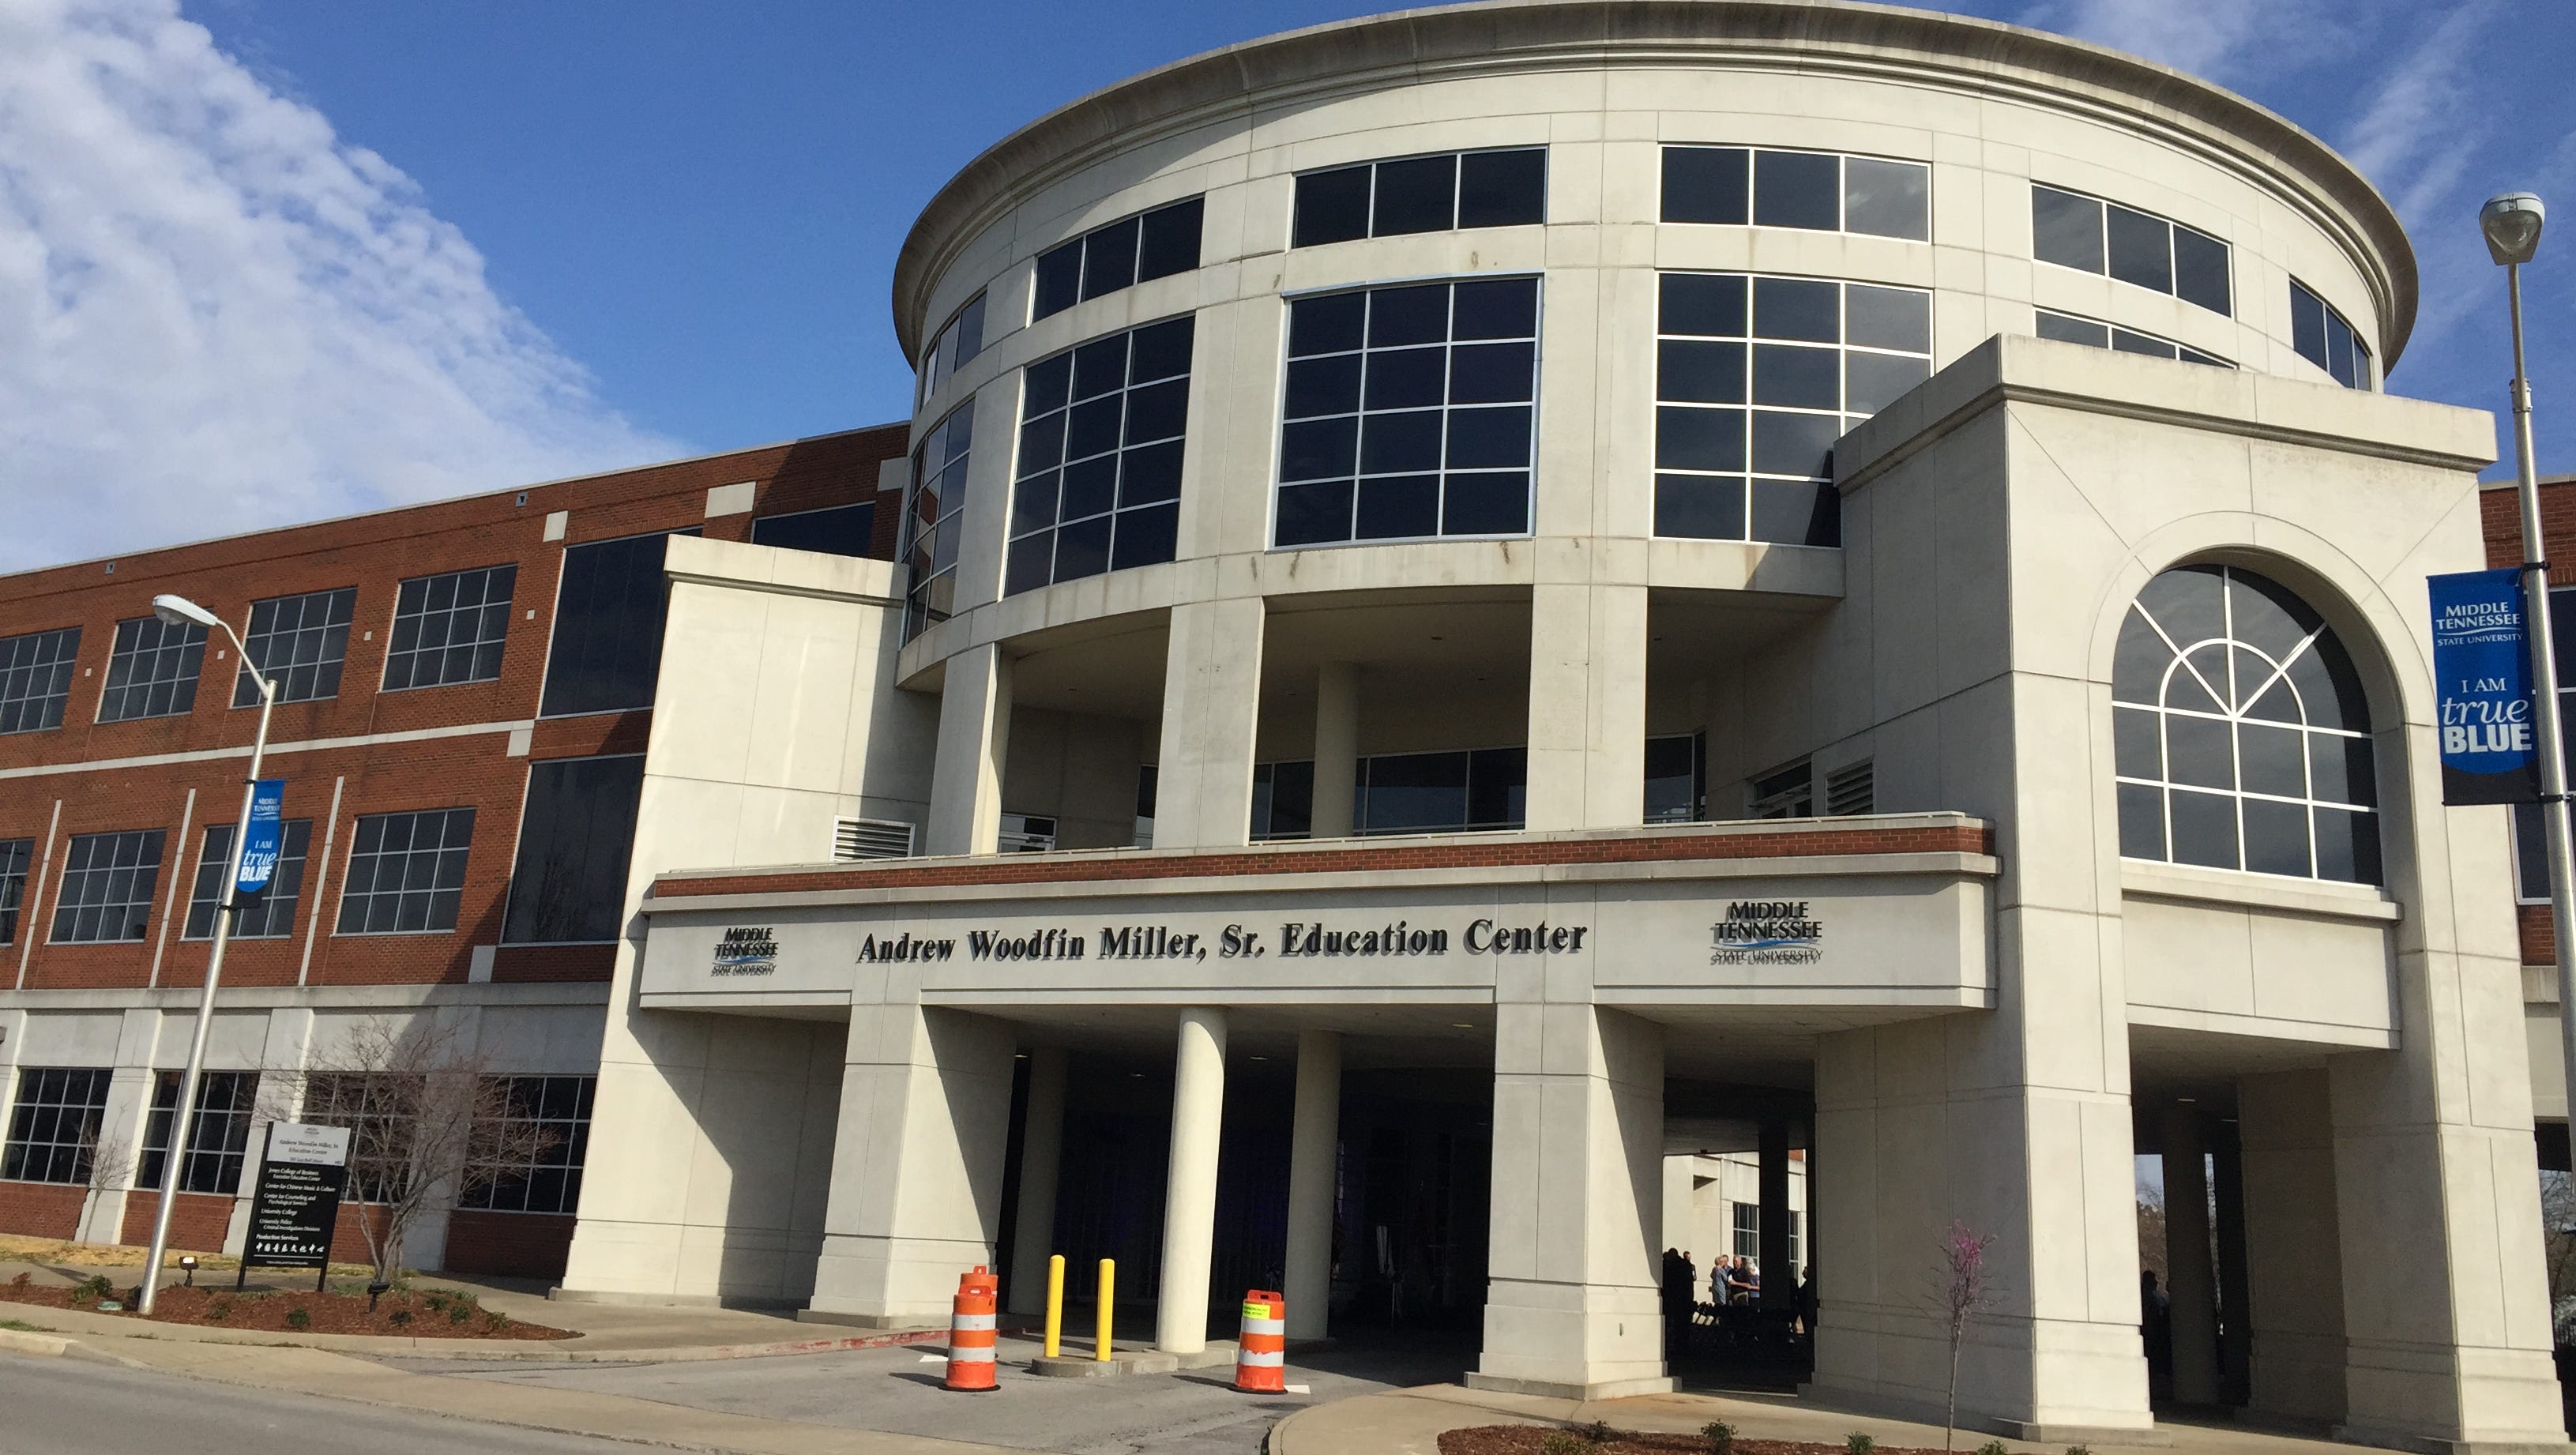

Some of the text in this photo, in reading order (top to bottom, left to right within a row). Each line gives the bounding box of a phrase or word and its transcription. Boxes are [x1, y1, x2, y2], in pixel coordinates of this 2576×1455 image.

[2446, 601, 2509, 617] MIDDLE
[2435, 614, 2521, 630] TENNESSEE
[2437, 633, 2523, 646] STATE UNIVERSITY
[2461, 678, 2507, 693] I AM
[2442, 697, 2529, 725] true
[2443, 723, 2533, 754] BLUE
[243, 849, 277, 866] true
[239, 865, 273, 882] BLUE
[1730, 901, 1809, 919] MIDDLE
[724, 927, 773, 942] MIDDLE
[1715, 921, 1822, 939] TENNESSEE
[716, 942, 779, 957] TENNESSEE
[857, 919, 1588, 964] Andrew Woodfin Miller, Sr. Education Center
[1716, 950, 1823, 961] STATE UNIVERSITY
